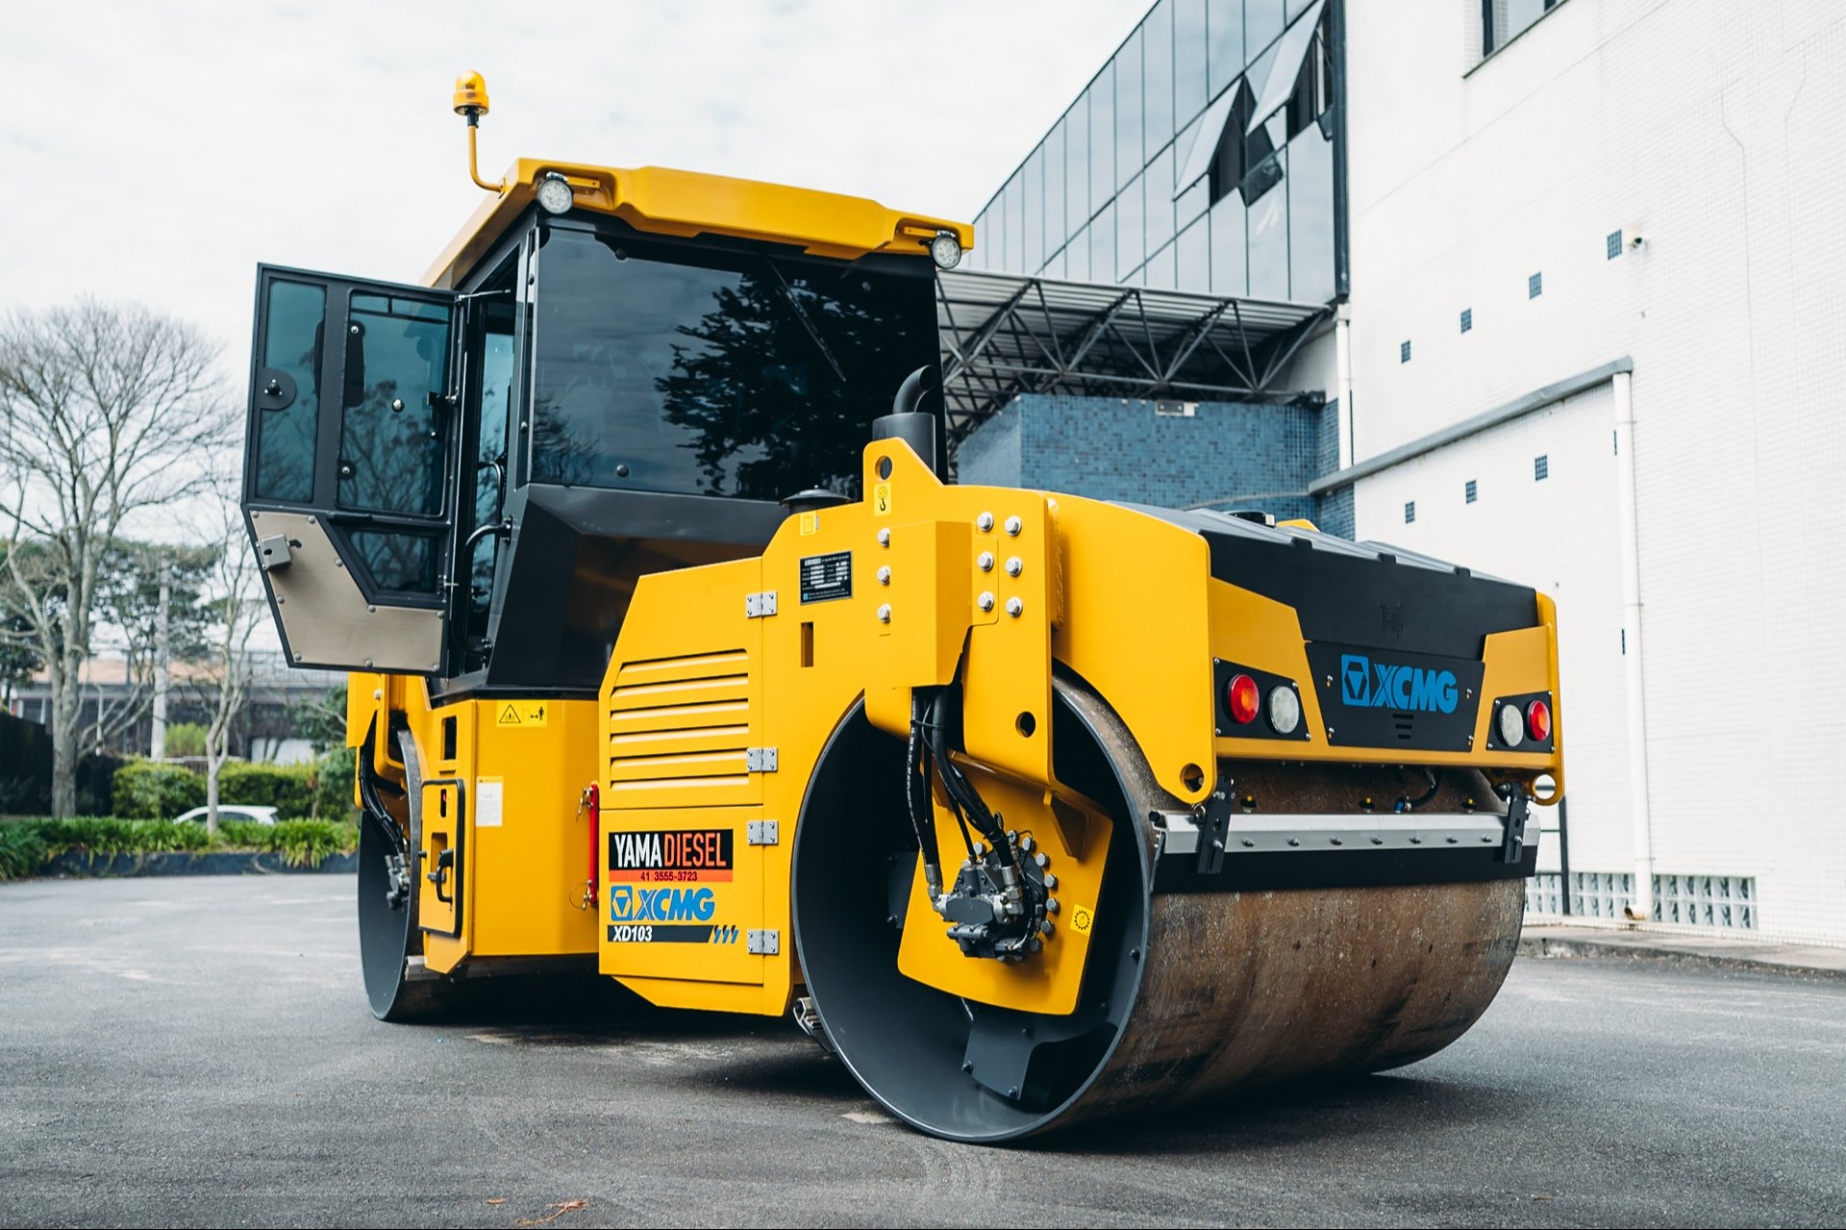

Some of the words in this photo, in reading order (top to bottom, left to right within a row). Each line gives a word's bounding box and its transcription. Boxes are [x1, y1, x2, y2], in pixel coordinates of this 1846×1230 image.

[1370, 663, 1458, 714] XCMG
[640, 871, 650, 882] 41
[654, 871, 698, 882] 3555-3723
[633, 887, 715, 921] XCMG
[613, 925, 653, 942] XD103
